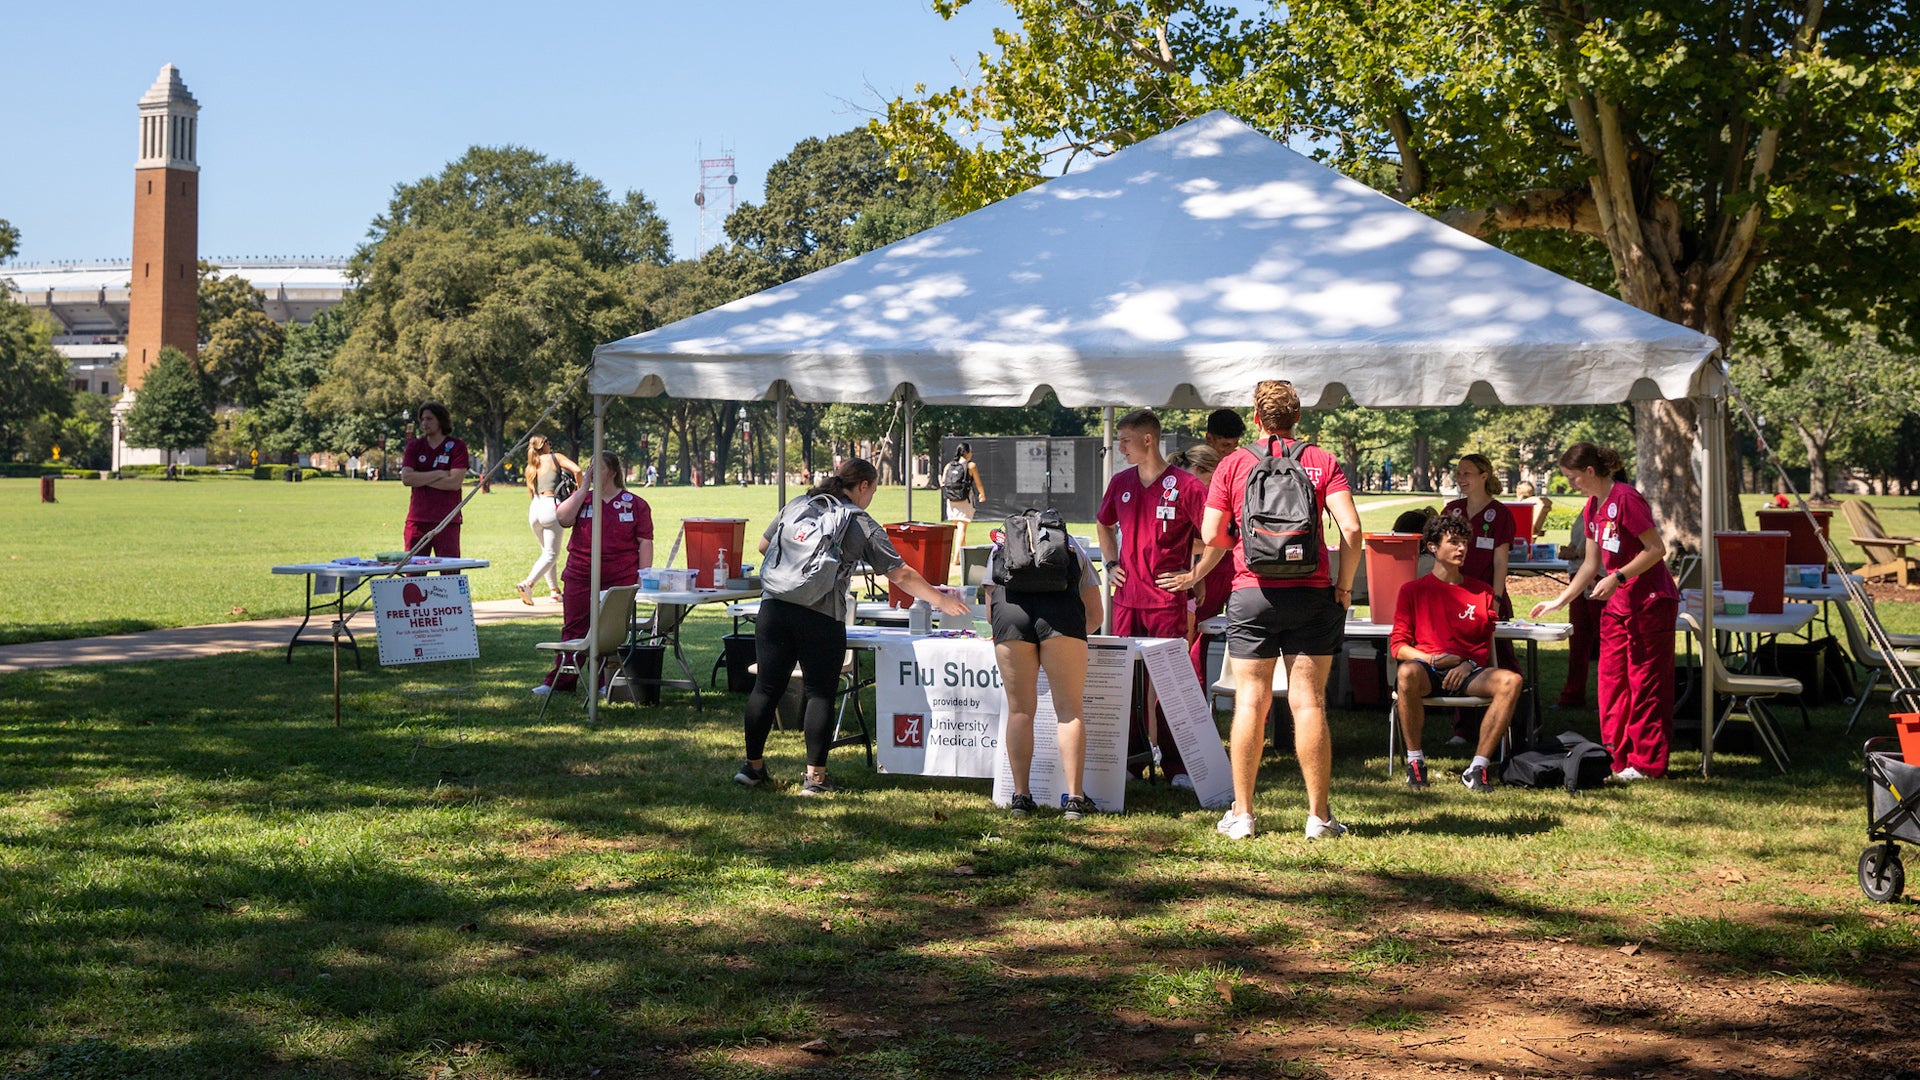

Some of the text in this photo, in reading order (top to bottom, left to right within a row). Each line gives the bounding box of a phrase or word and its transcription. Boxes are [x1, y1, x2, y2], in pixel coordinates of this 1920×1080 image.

[387, 607, 463, 619] FREE FLU SHOTS
[1458, 603, 1476, 620] A
[410, 618, 443, 628] HERE!
[900, 661, 935, 687] Flu
[943, 661, 1003, 689] Shot
[933, 698, 981, 709] provided by
[896, 718, 920, 744] A
[930, 718, 989, 736] University
[930, 734, 998, 748] Medical Ce
